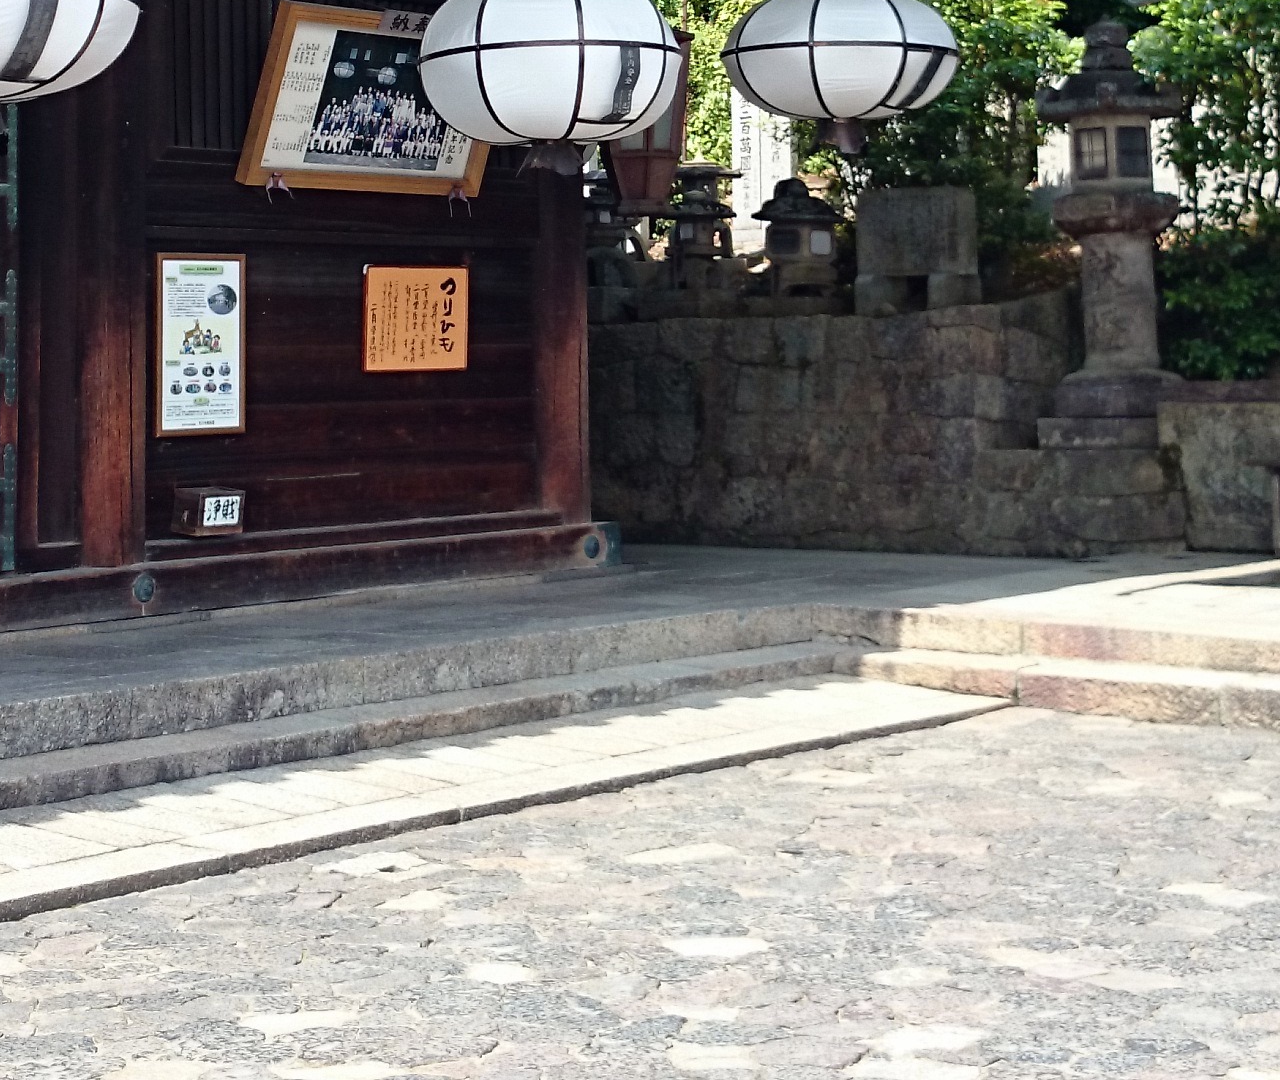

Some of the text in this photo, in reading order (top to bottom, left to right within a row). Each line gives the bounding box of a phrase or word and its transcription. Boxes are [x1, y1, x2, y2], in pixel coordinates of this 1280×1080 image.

[438, 277, 457, 354] つりひも
[206, 498, 238, 522] 浄財
